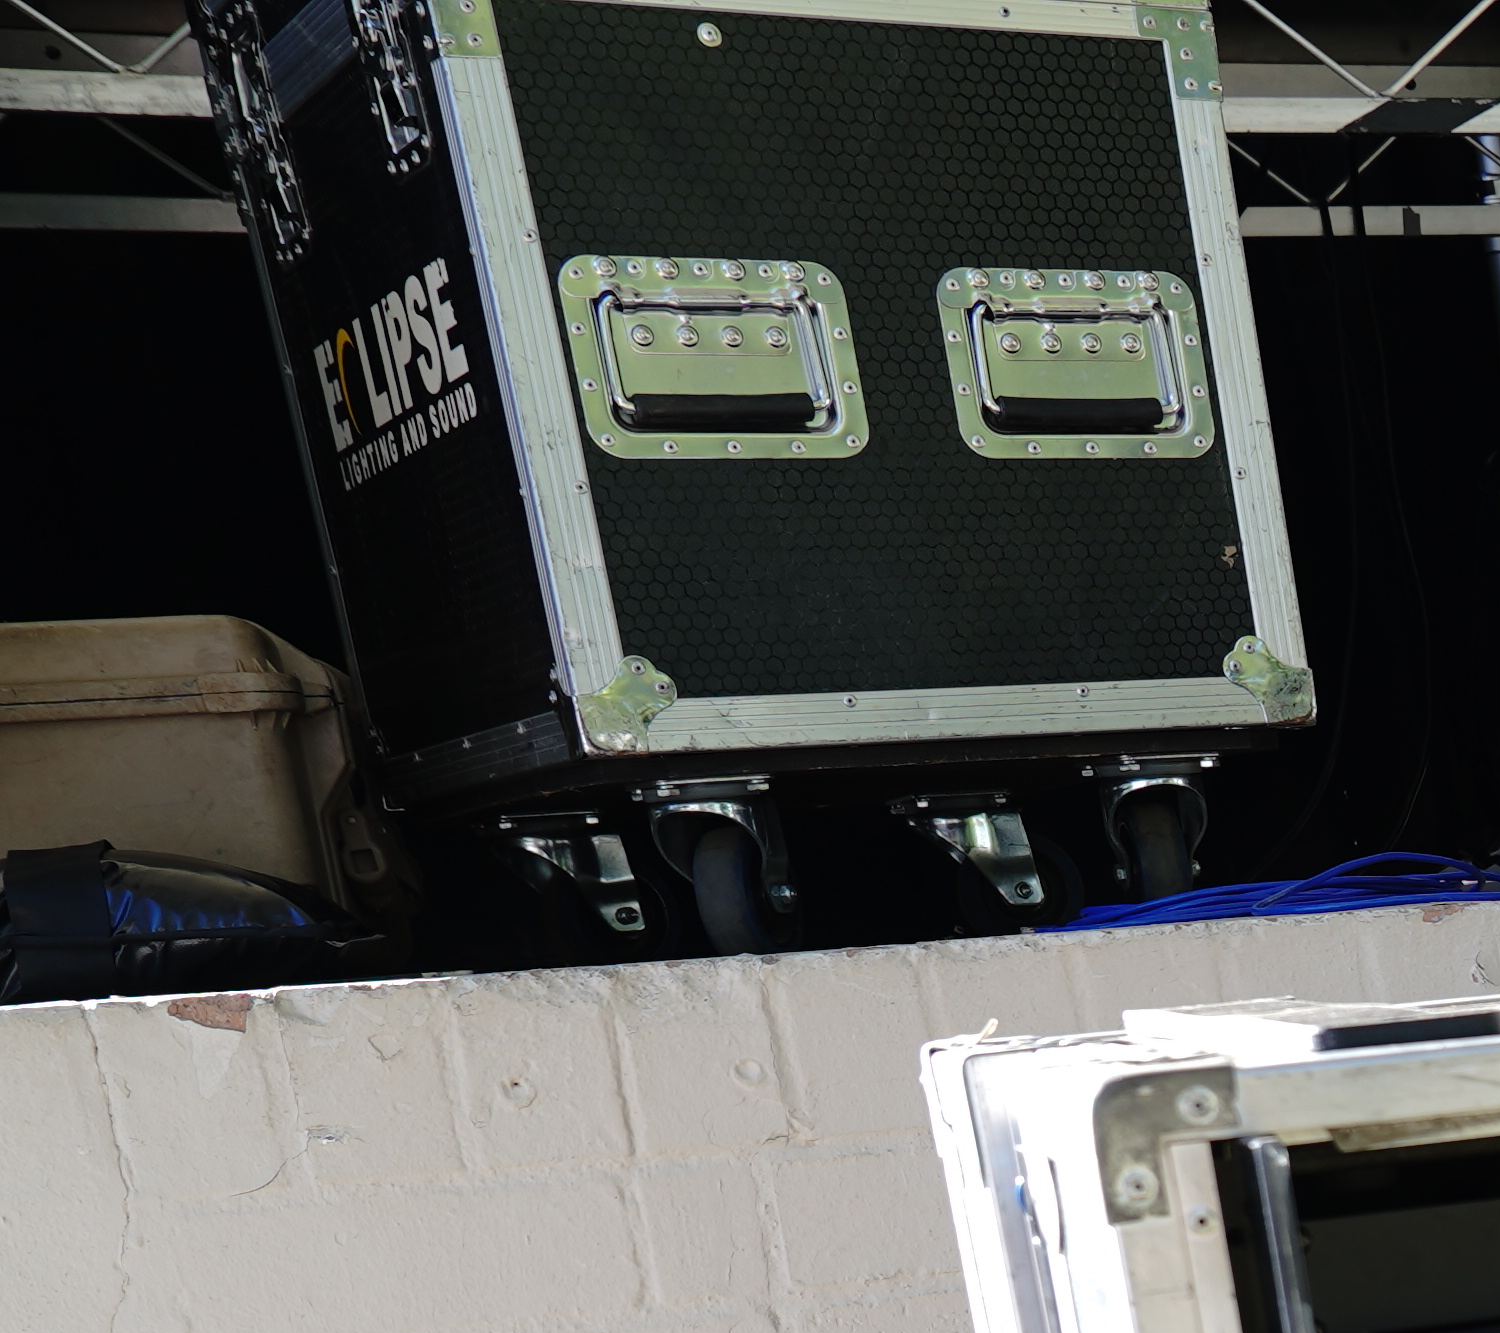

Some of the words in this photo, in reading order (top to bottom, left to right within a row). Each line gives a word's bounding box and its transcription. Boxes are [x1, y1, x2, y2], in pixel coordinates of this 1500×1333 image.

[313, 257, 469, 452] ECLIPSE
[339, 431, 398, 491] LIGHTING
[400, 412, 428, 456] AND
[429, 382, 478, 438] SOUND
